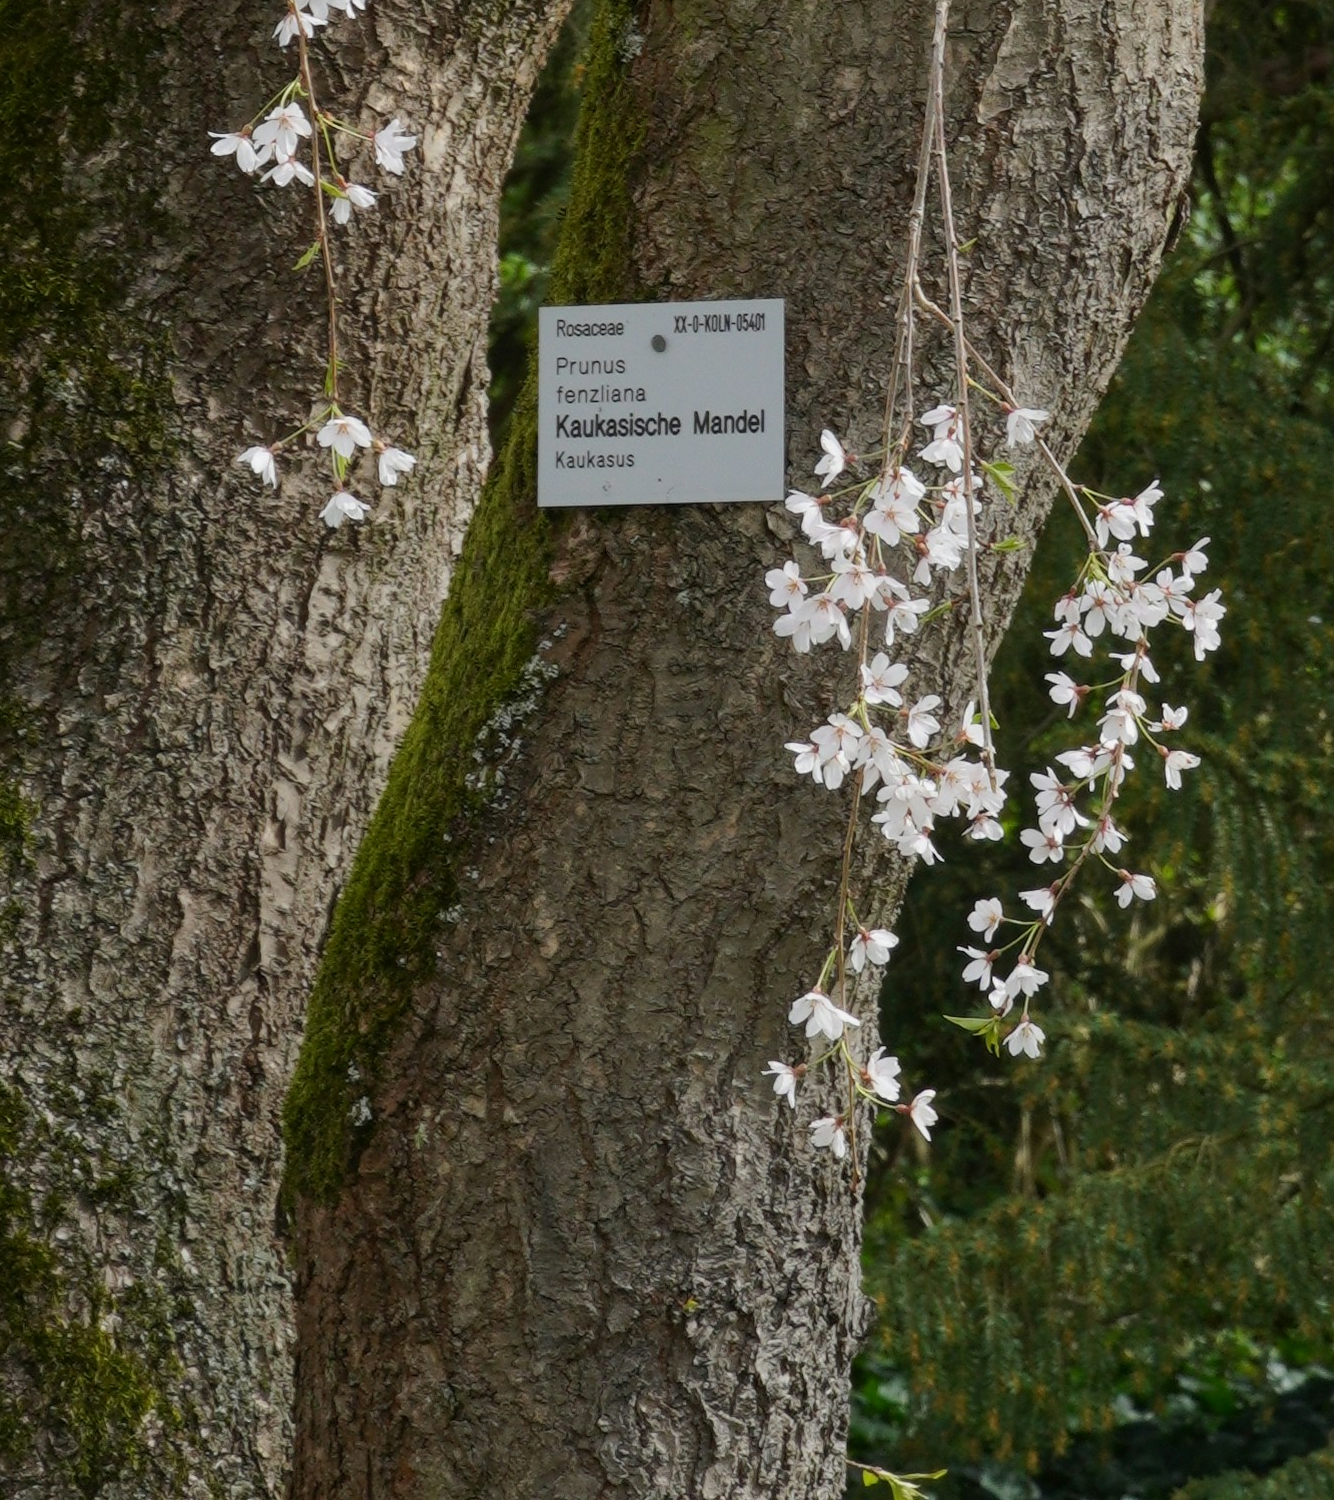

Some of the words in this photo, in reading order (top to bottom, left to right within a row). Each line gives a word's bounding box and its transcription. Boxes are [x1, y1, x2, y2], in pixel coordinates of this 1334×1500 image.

[556, 319, 625, 337] Rosaceae
[556, 357, 626, 375] Prunus
[557, 385, 647, 403] fenzliana
[555, 412, 682, 439] Kaukasische
[693, 409, 765, 435] Mandel
[555, 451, 635, 469] Kaukasus
